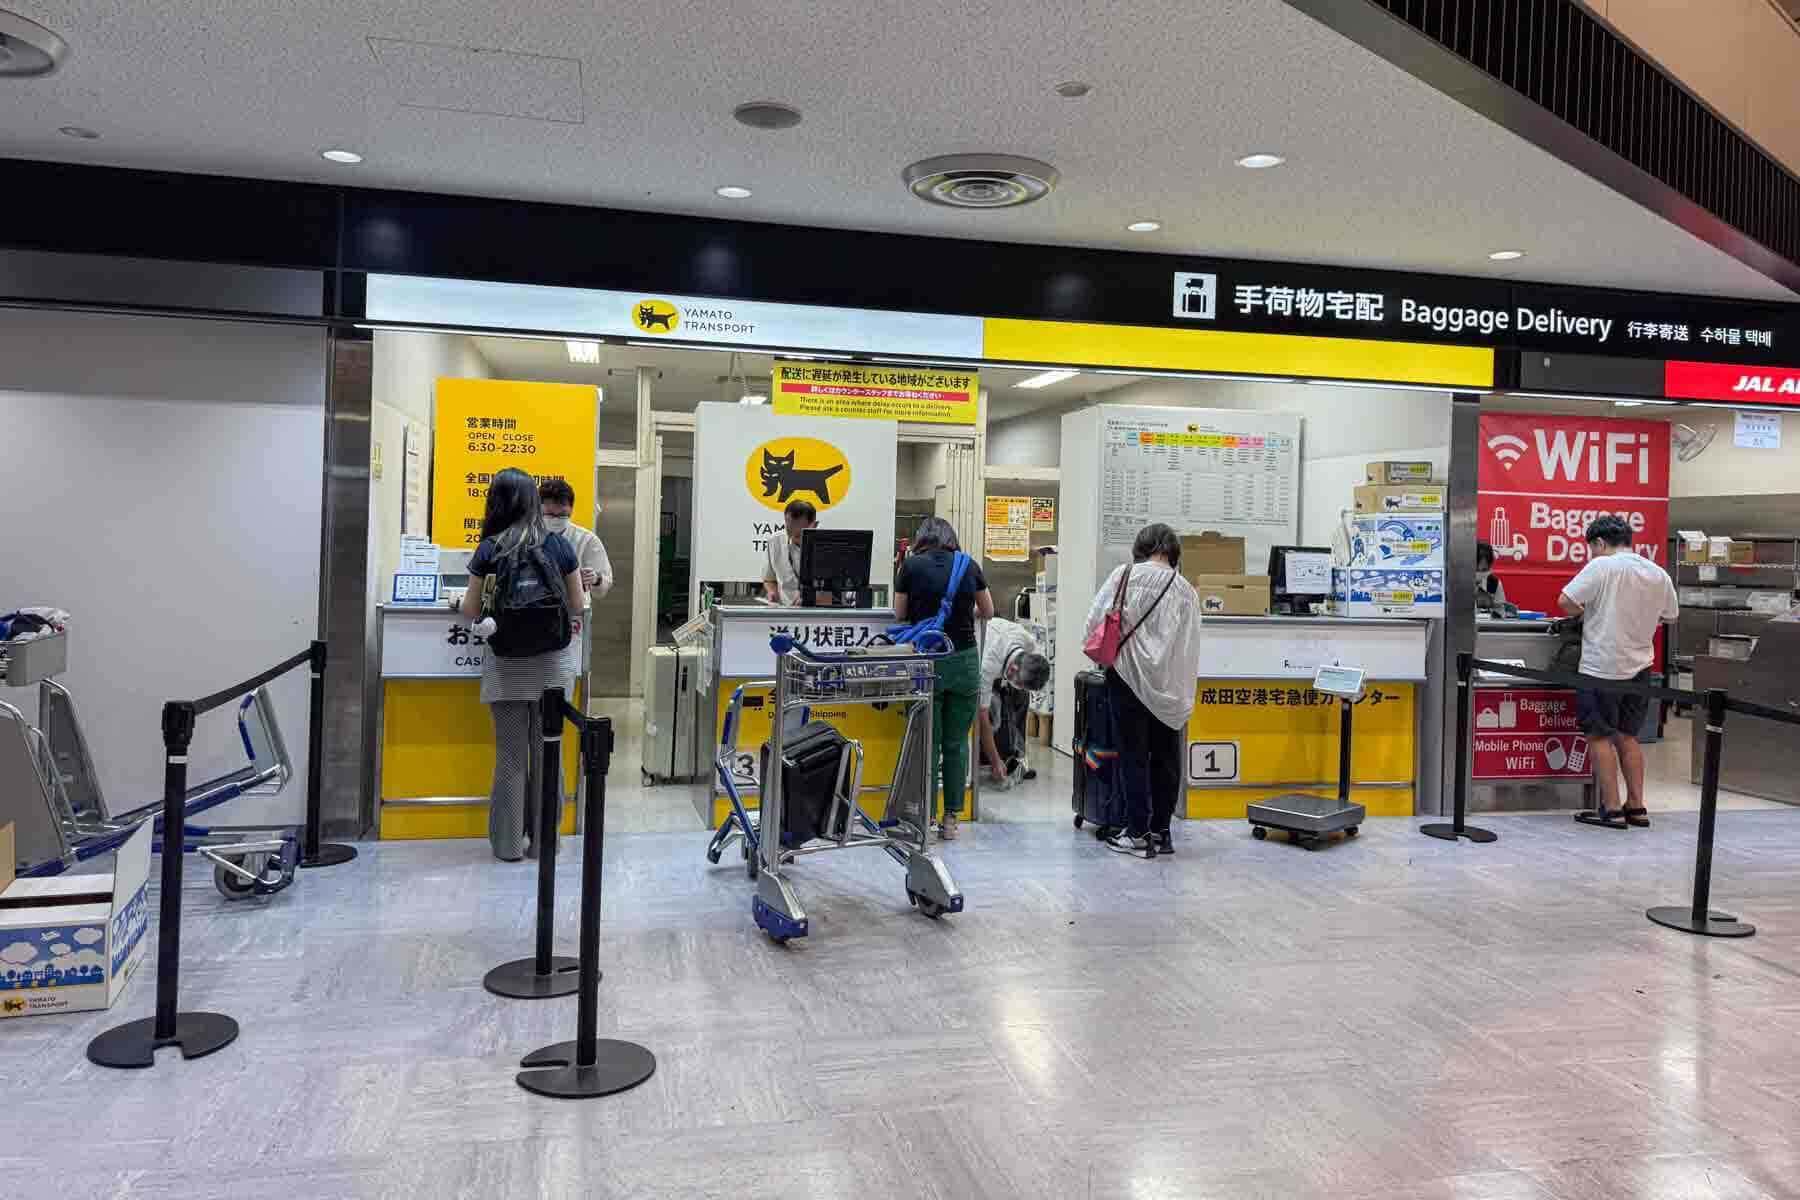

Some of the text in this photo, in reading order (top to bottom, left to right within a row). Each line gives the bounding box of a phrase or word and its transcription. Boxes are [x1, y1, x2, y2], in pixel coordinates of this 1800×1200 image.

[1234, 284, 1384, 321] 手荷物宅配
[685, 308, 732, 319] YAMATO
[1402, 298, 1612, 342] Baggage Delivery
[685, 321, 755, 333] TRANSPORT
[1627, 321, 1689, 341] 行李寄送
[1700, 327, 1772, 347] 수하물 택배
[781, 368, 970, 389] 配送に遅延が発生している地域がございます
[1732, 375, 1775, 392] JAL
[466, 416, 517, 430] 営業時間
[468, 432, 495, 440] OPEN
[1534, 429, 1649, 484] WiFi
[1529, 502, 1645, 537] Bagge
[1547, 535, 1659, 563] Delry
[1201, 688, 1401, 705] 成田空港宅急便カンター
[1520, 699, 1568, 713] Baggage
[1539, 714, 1581, 728] Deliver
[1474, 740, 1544, 752] Mobile Phone
[738, 755, 754, 776] 3
[1204, 750, 1221, 773] 1
[1505, 757, 1537, 770] WiFi
